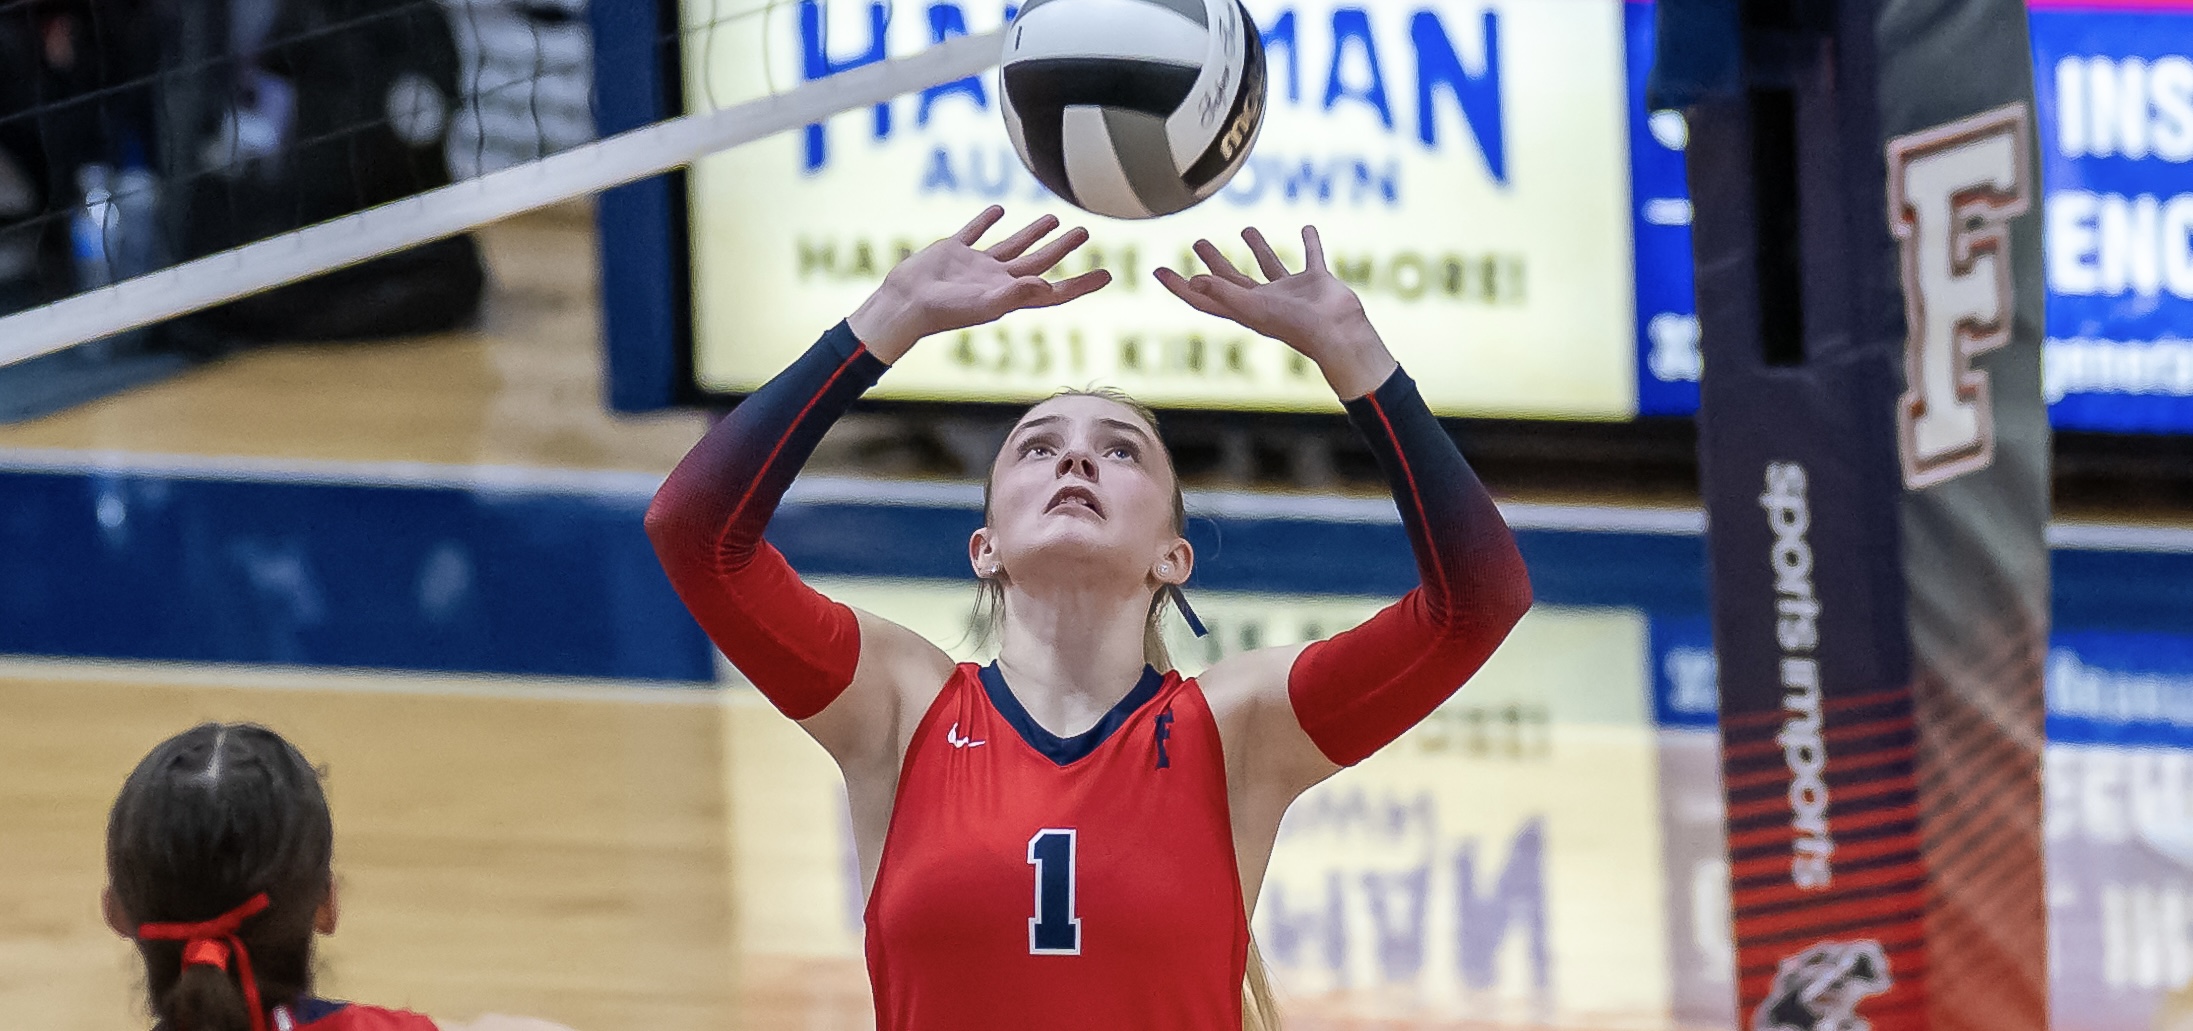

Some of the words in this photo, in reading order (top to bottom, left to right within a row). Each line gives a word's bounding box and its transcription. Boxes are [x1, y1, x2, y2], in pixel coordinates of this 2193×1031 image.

[1886, 101, 2030, 490] F
[1759, 461, 1822, 651] sports
[1027, 828, 1082, 956] 1
